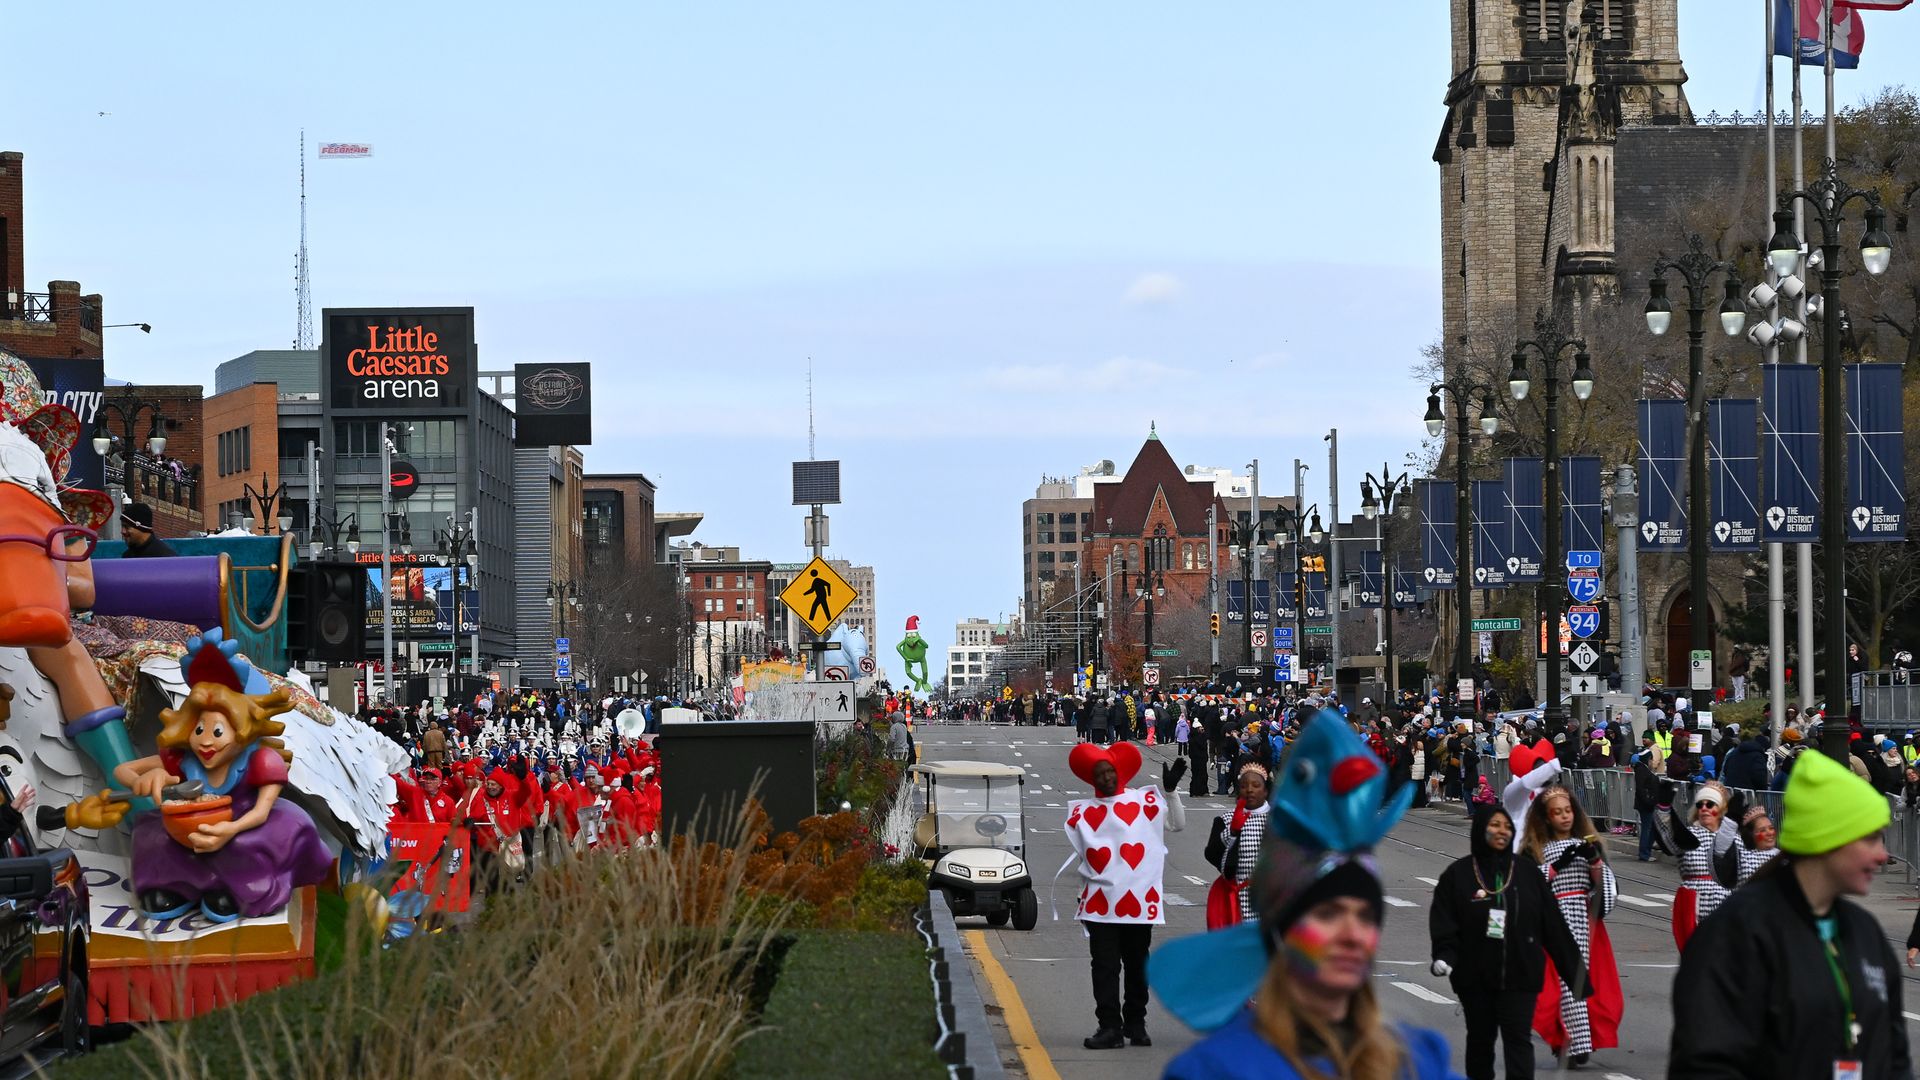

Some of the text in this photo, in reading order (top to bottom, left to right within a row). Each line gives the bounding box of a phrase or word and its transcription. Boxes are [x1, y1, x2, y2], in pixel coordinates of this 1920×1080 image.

[368, 325, 438, 352] Little
[348, 349, 449, 376] Caesars
[364, 379, 438, 398] arena
[64, 391, 102, 423] CITY
[1787, 524, 1812, 532] DETROIT
[1873, 523, 1897, 531] DETROIT
[355, 552, 380, 562] Little
[1577, 555, 1591, 563] TO
[1571, 579, 1596, 596] 75
[1474, 621, 1511, 629] Montcalm
[1570, 614, 1595, 631] 94
[559, 658, 568, 666] 75
[1276, 654, 1290, 664] 75
[1578, 653, 1591, 664] 10
[1145, 791, 1155, 803] 6
